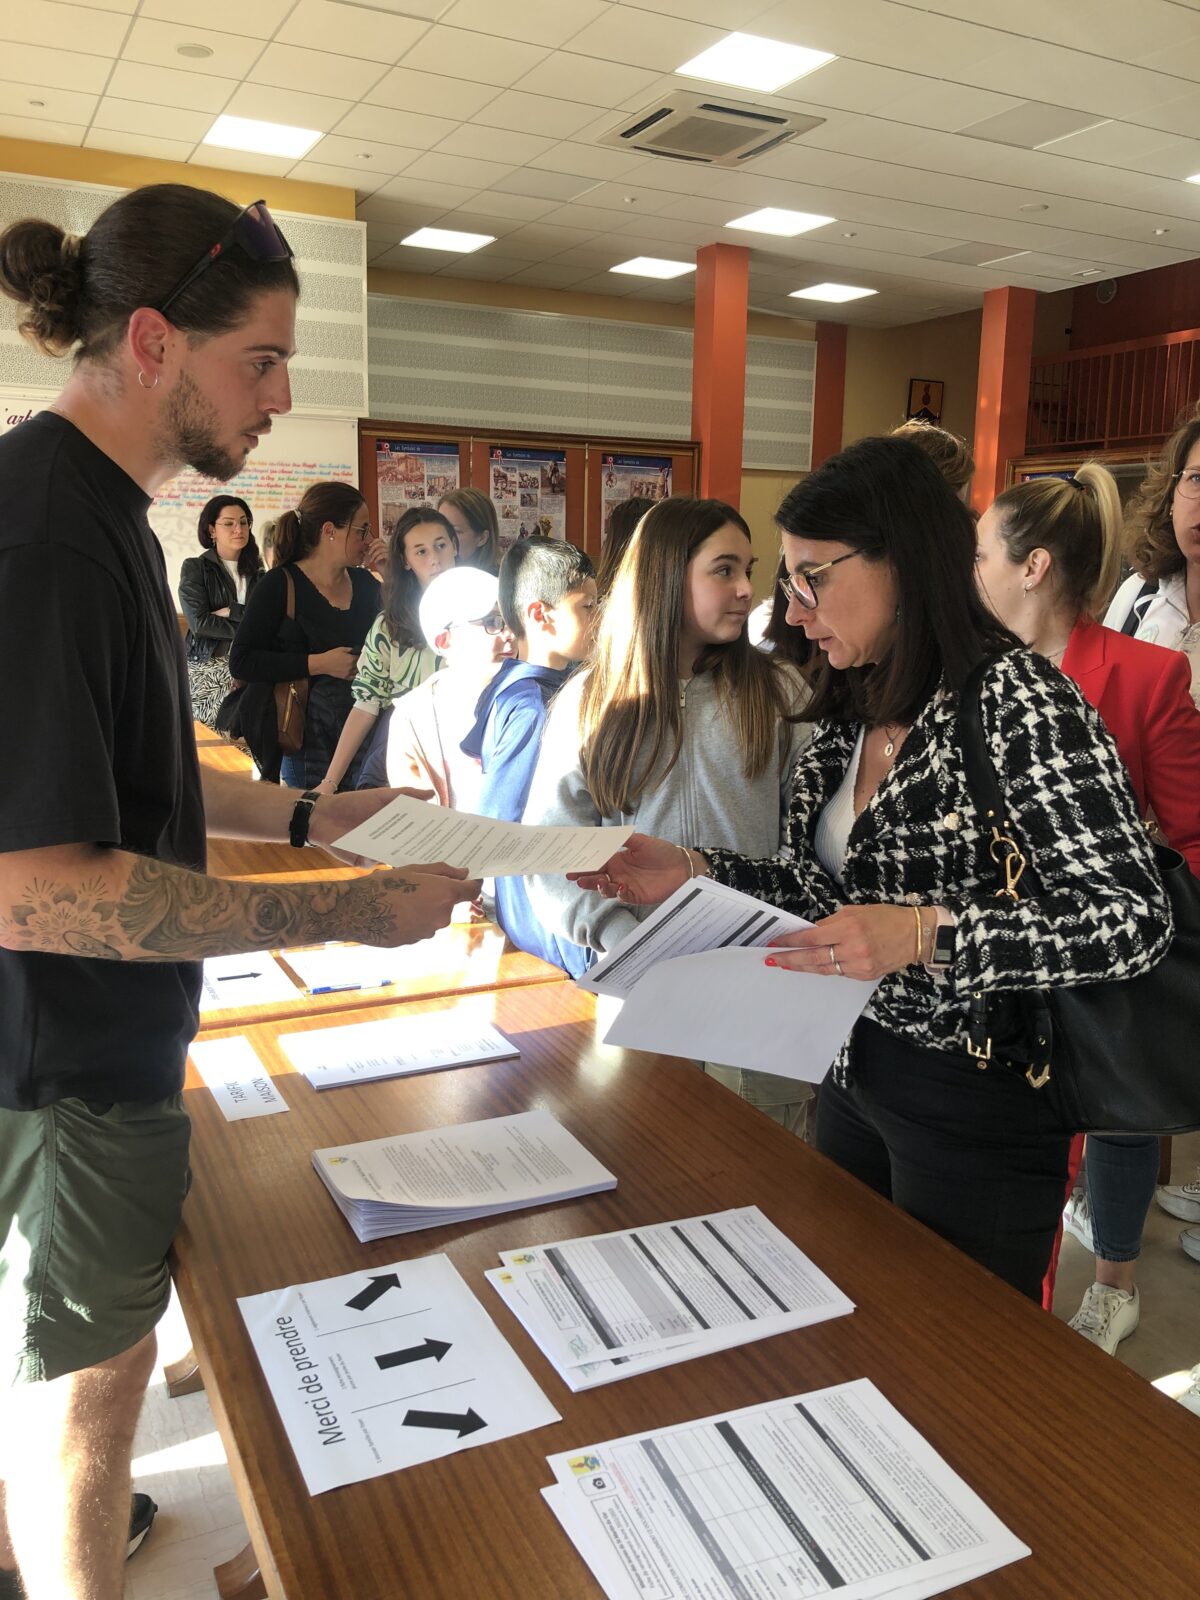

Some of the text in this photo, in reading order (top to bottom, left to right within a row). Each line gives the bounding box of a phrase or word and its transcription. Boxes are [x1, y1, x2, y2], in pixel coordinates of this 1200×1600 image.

[251, 1078, 278, 1103] MAISON
[274, 1315, 346, 1446] Merci de prendre
